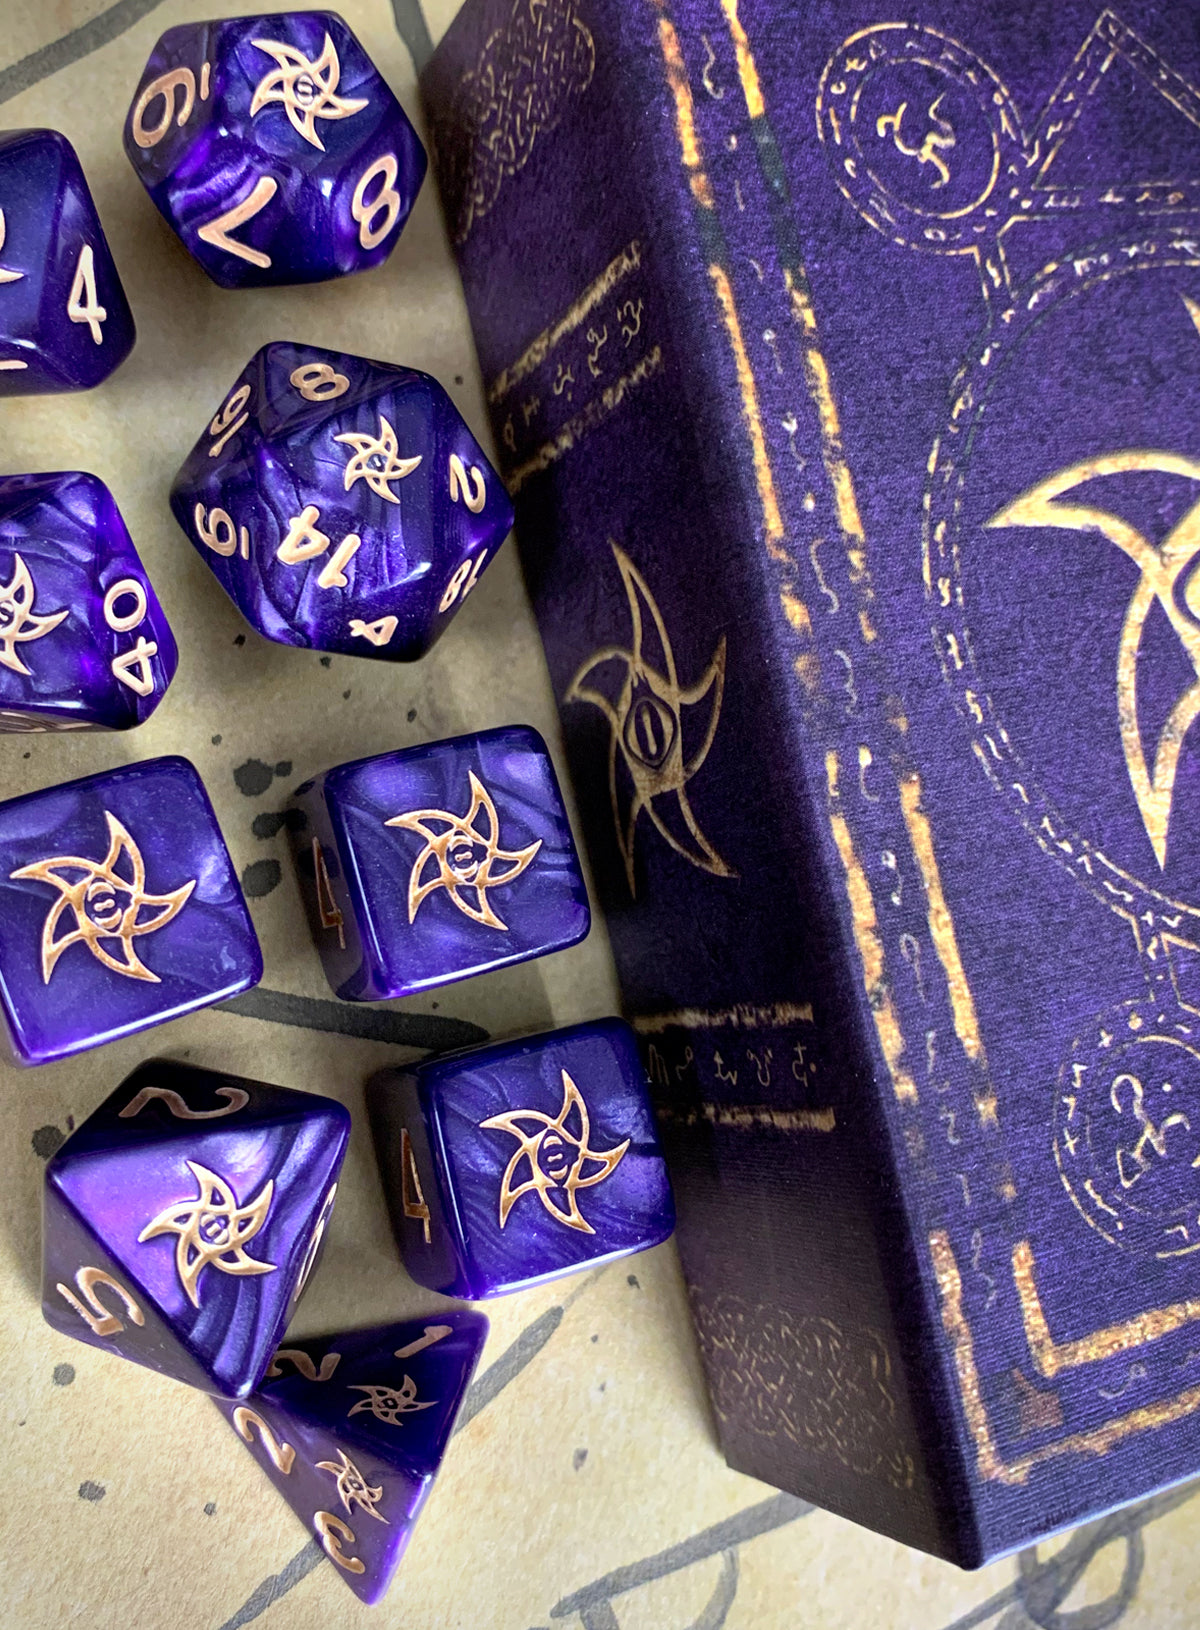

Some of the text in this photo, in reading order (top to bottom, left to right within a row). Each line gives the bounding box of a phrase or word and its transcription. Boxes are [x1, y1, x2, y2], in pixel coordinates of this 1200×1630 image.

[198, 176, 278, 269] 7
[351, 154, 401, 250] 8
[67, 244, 108, 345] 4
[290, 362, 350, 402] 8
[449, 454, 486, 514] 2
[276, 505, 361, 589] 14
[348, 615, 399, 646] 4
[312, 836, 347, 949] 4
[117, 1086, 250, 1118] 2
[400, 1127, 433, 1244] 4
[55, 1265, 145, 1336] 5
[394, 1325, 453, 1358] 1
[232, 1406, 296, 1474] 2
[313, 1511, 365, 1574] 3
